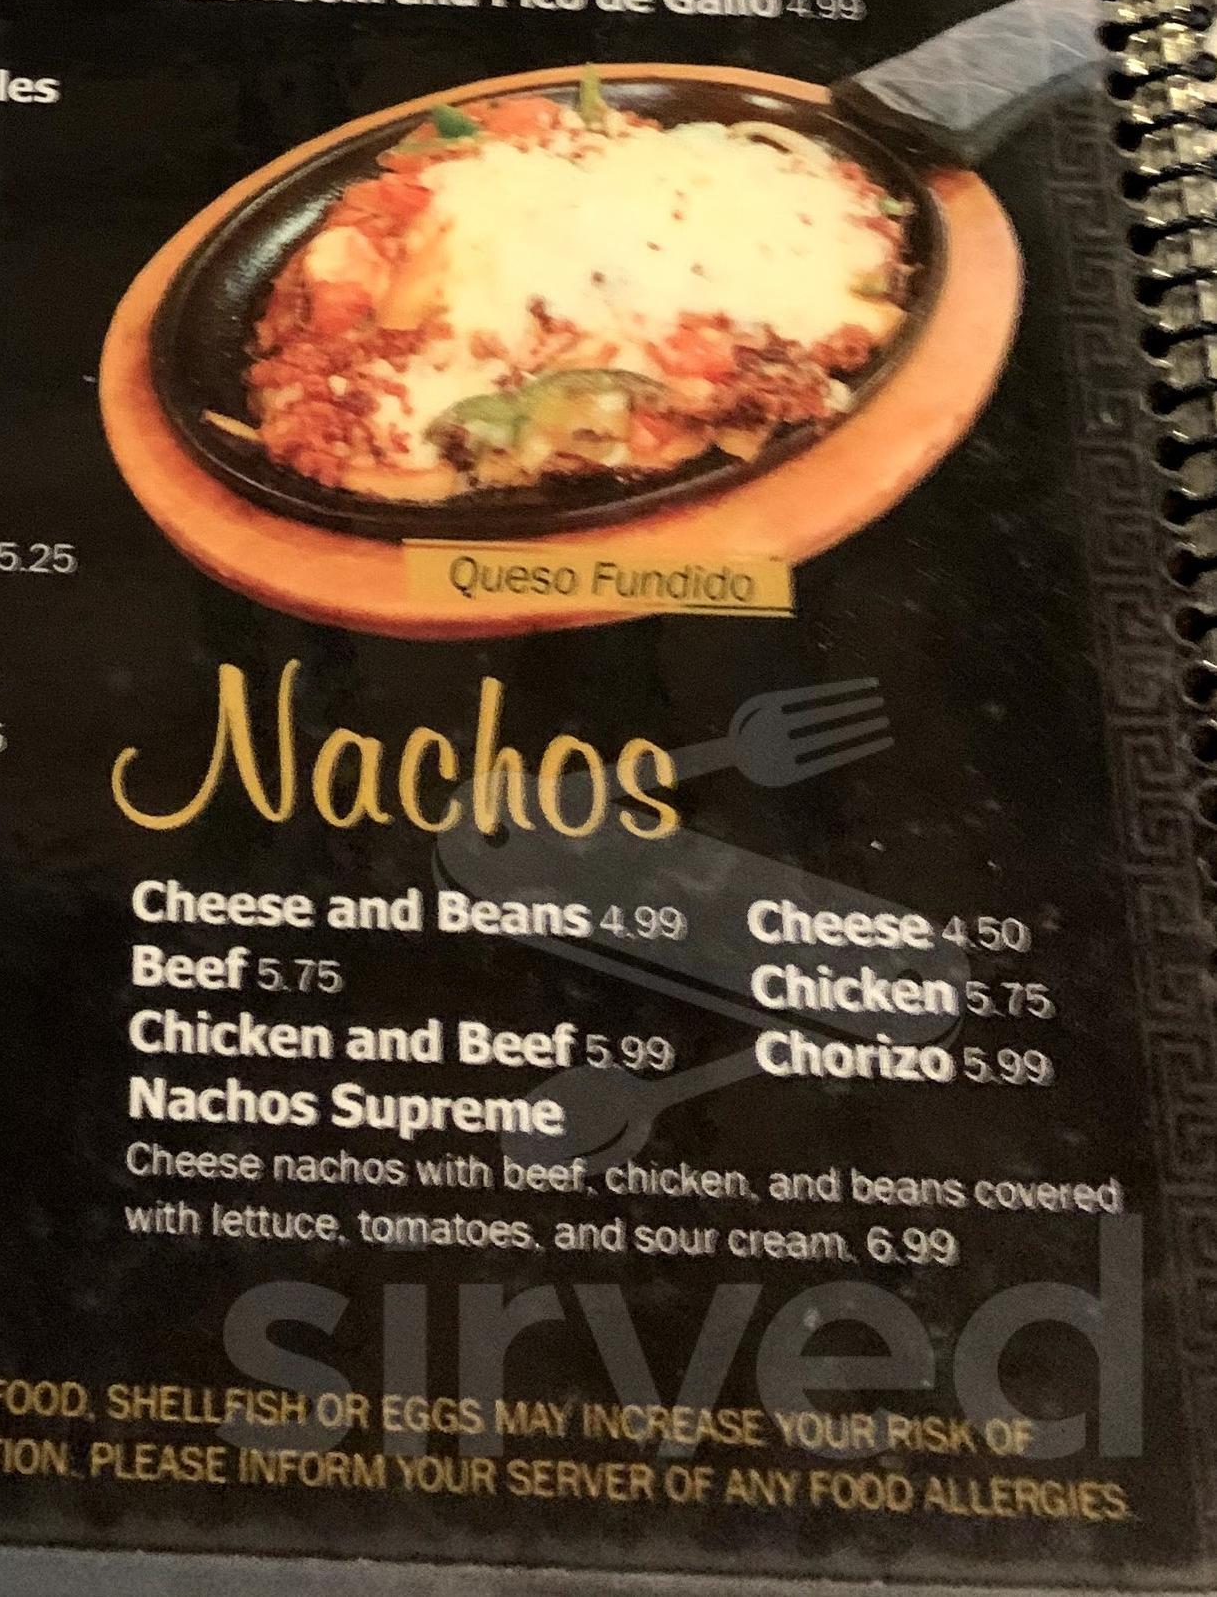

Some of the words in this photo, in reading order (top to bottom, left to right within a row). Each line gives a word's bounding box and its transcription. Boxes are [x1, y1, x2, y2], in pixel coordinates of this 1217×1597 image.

[450, 556, 579, 599] Queso
[592, 561, 755, 606] Fundido
[112, 659, 680, 840] Nachos
[132, 880, 313, 927] Cheese
[328, 889, 422, 931] and
[438, 891, 590, 936] Beans
[600, 905, 684, 939] 4.99
[751, 965, 959, 1015] Chicken
[966, 981, 1050, 1018] 5.75
[129, 1077, 318, 1126] Nachos
[332, 1083, 564, 1140] Supreme
[125, 1200, 200, 1235] with
[555, 1217, 625, 1252] and
[634, 1225, 719, 1256] sour
[867, 1226, 956, 1266] 6.99
